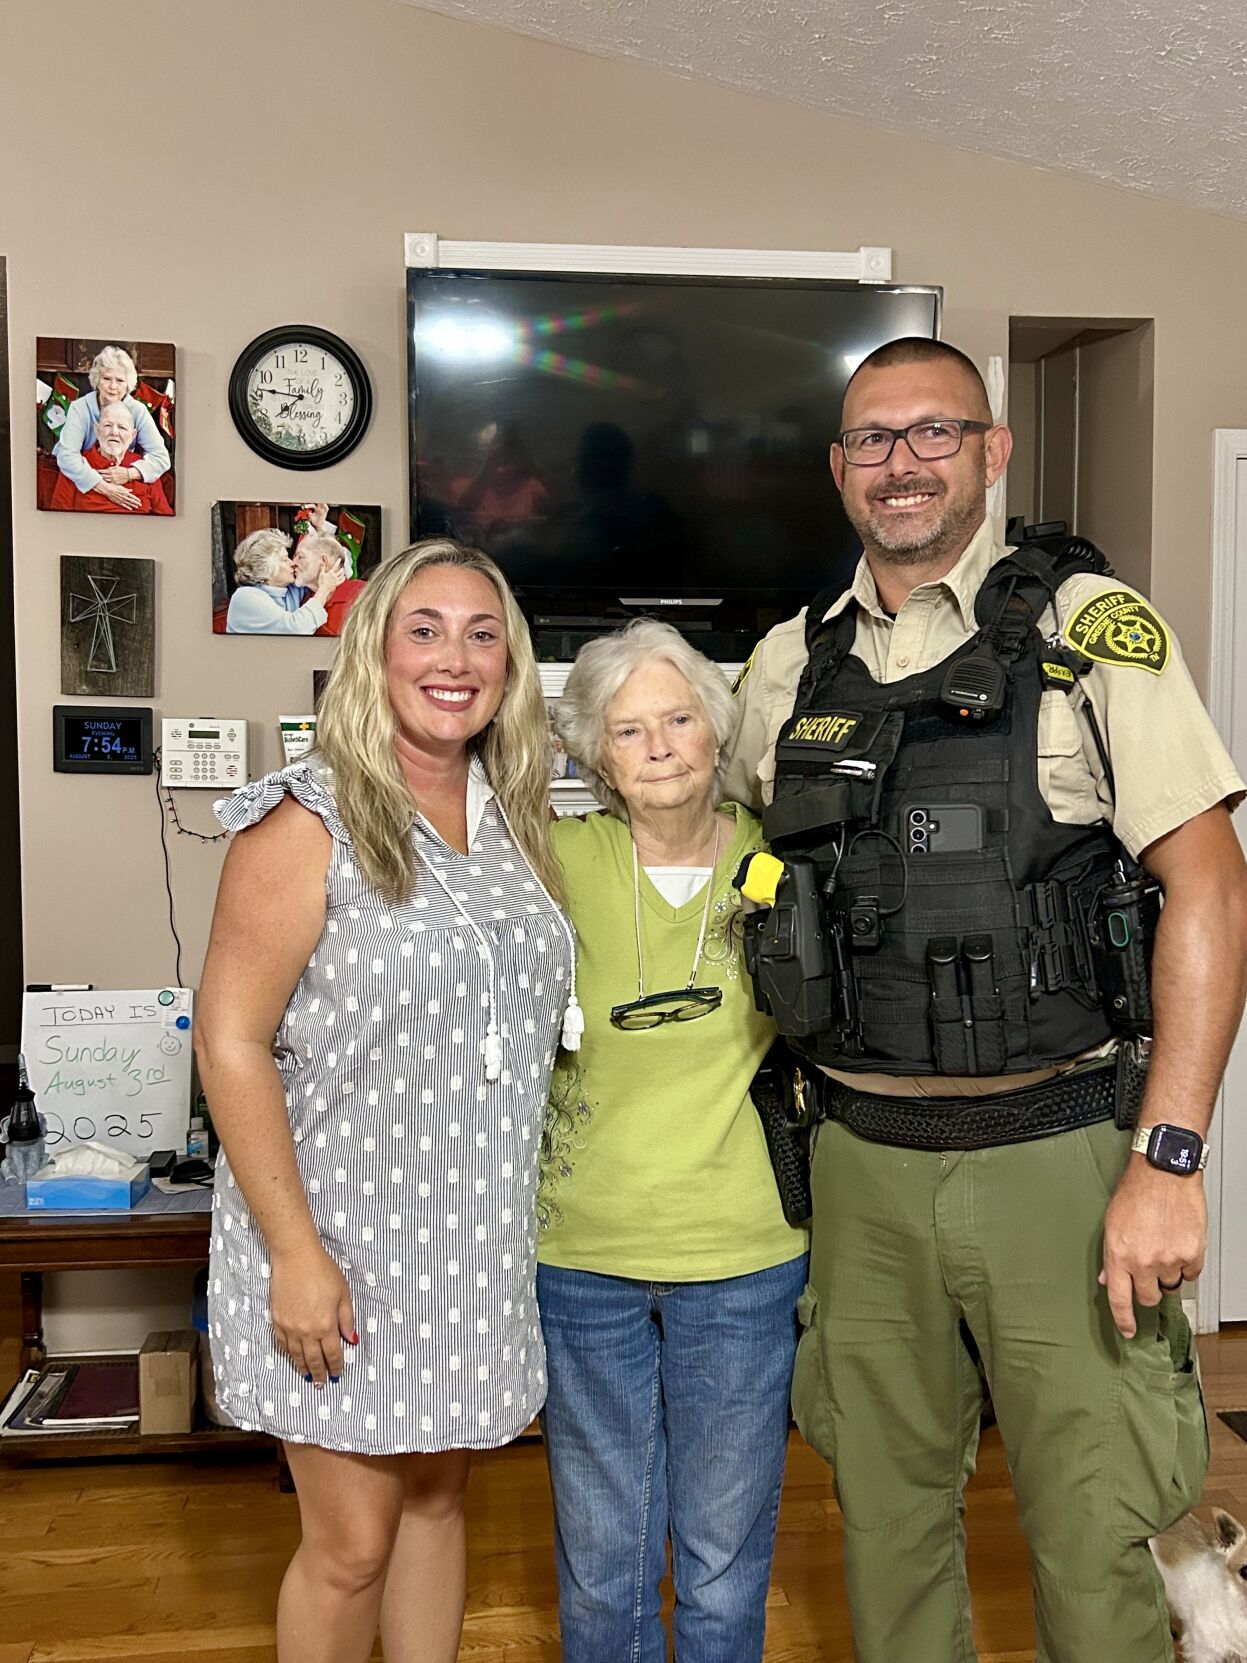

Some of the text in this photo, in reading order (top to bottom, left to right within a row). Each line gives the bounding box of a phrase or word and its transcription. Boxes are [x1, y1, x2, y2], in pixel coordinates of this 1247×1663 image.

[275, 355, 285, 369] 11
[294, 349, 308, 363] 12
[321, 357, 325, 370] 1
[260, 370, 273, 384] 10
[334, 373, 343, 387] 2
[283, 378, 324, 404] Family
[338, 392, 348, 406] 3
[260, 408, 269, 420] 8
[279, 402, 324, 428] Blessing
[334, 411, 342, 424] 4
[1075, 594, 1125, 634] SHERIFF
[1088, 616, 1114, 644] GREENE
[1110, 605, 1139, 619] COUNTY
[84, 721, 122, 730] SUNDAY
[789, 716, 856, 743] SHERIFF
[81, 736, 121, 753] 7:54
[42, 1004, 157, 1026] TODAY IS
[39, 1035, 142, 1072] Sunday
[44, 1064, 172, 1097] August 3rd
[45, 1112, 162, 1145] 2025
